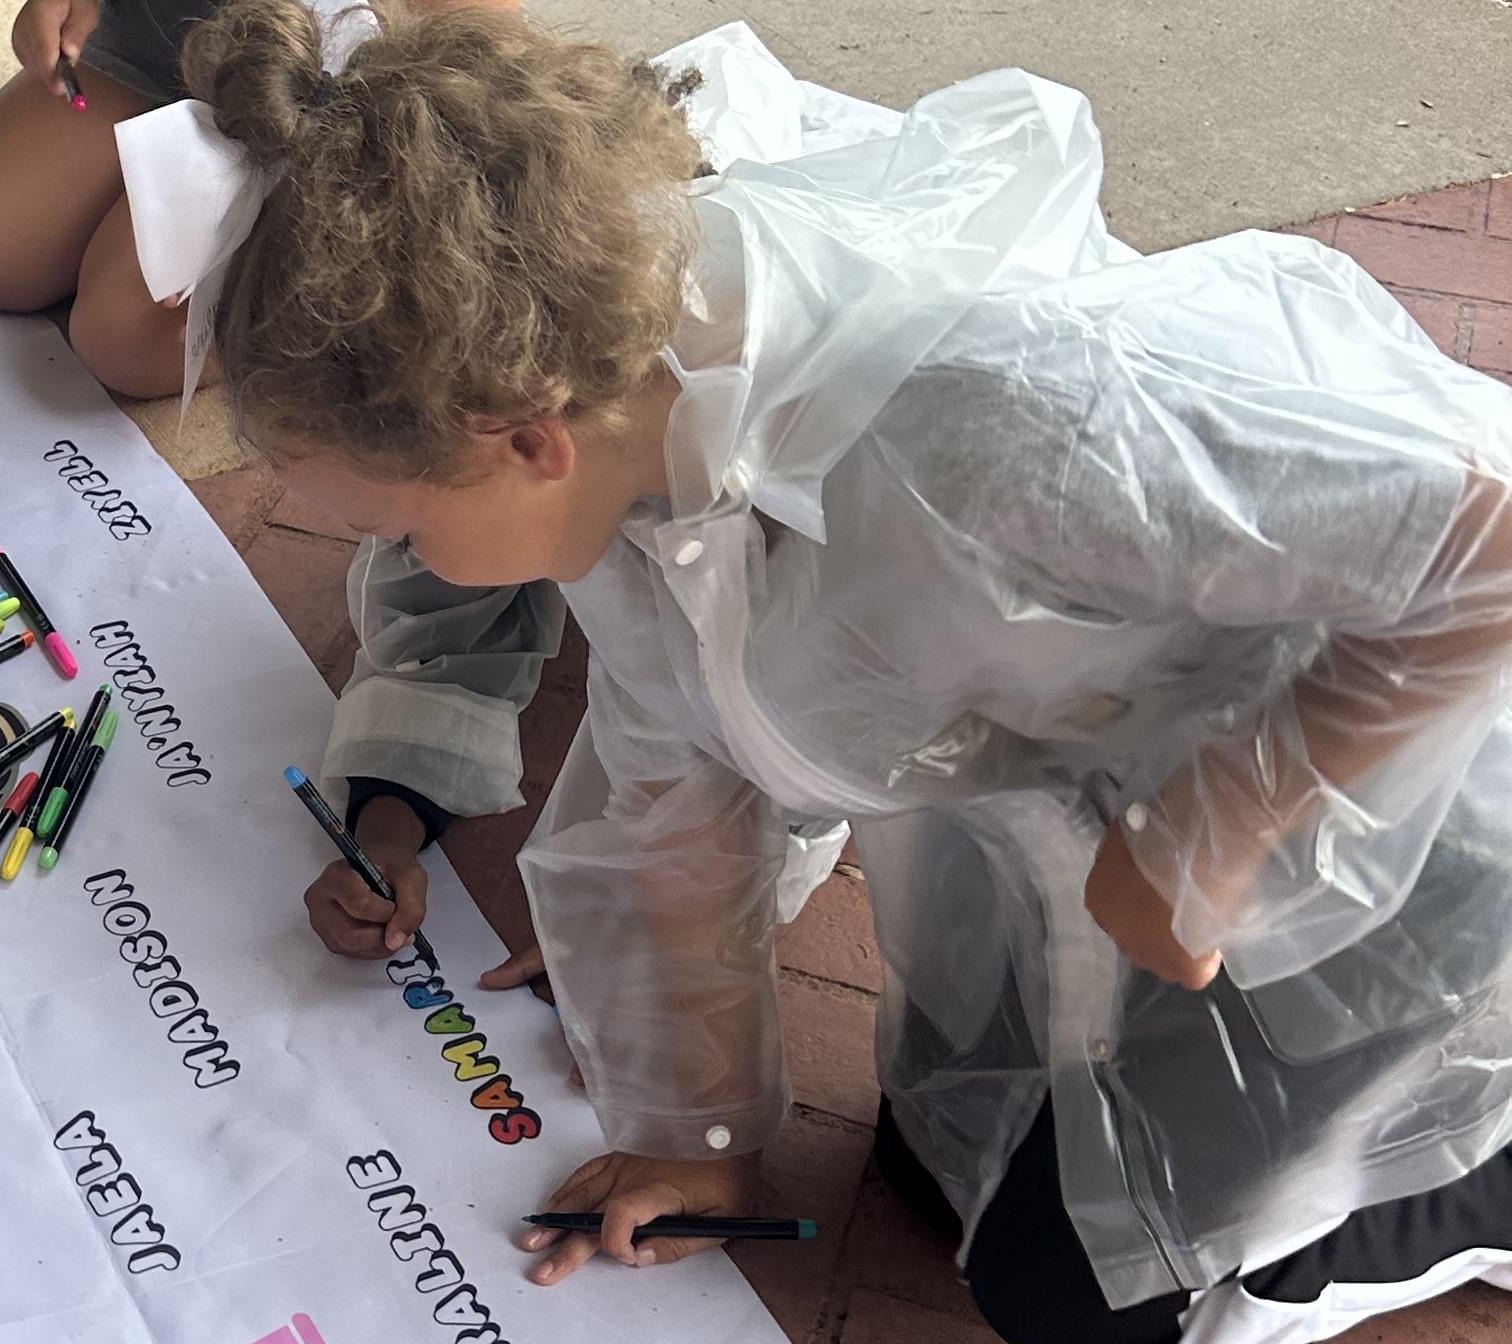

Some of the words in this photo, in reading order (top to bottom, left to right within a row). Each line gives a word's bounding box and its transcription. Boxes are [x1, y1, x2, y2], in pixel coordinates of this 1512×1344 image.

[43, 440, 153, 541] ZIYELL
[89, 620, 212, 787] JA'NYIAH
[83, 869, 241, 1089] MADISON
[386, 955, 542, 1145] SAMARI
[53, 1110, 181, 1275] JAELA
